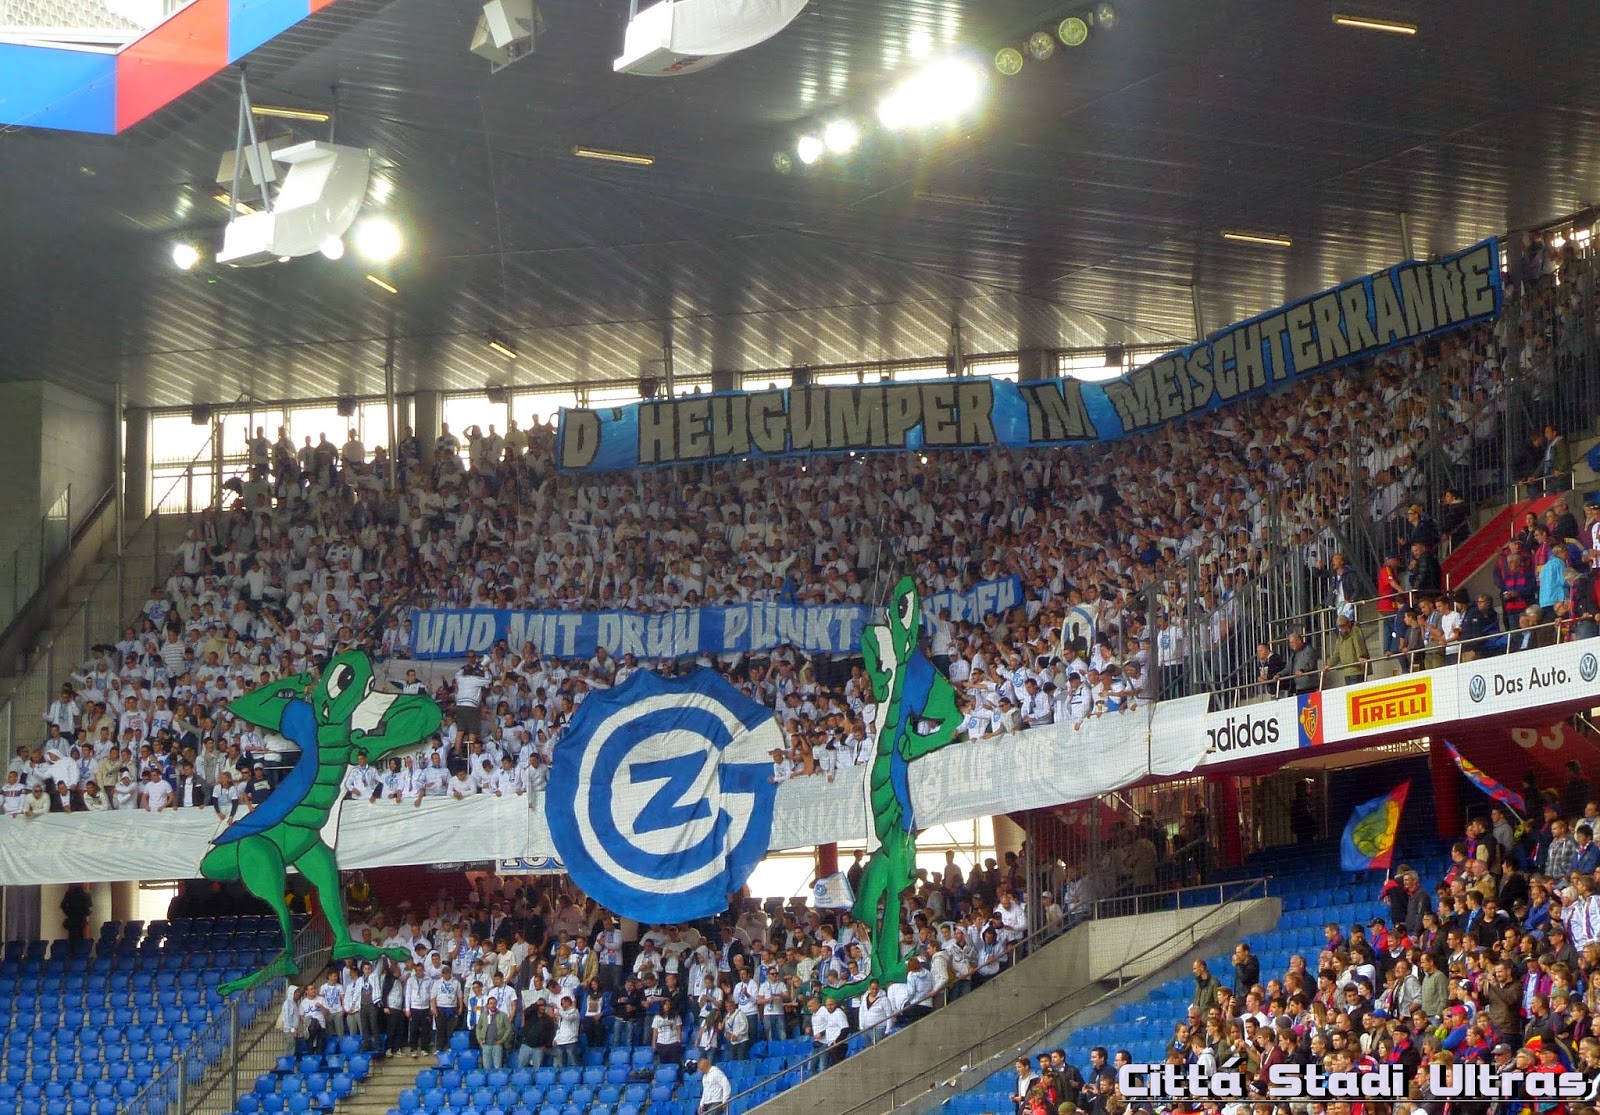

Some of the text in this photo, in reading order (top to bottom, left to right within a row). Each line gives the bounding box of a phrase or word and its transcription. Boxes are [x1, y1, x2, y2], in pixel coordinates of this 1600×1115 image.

[1016, 379, 1099, 443] IM
[415, 612, 497, 654] UND
[509, 612, 583, 655] MIT
[1494, 666, 1571, 697] Das Auto.
[1351, 682, 1428, 726] PIRELLI
